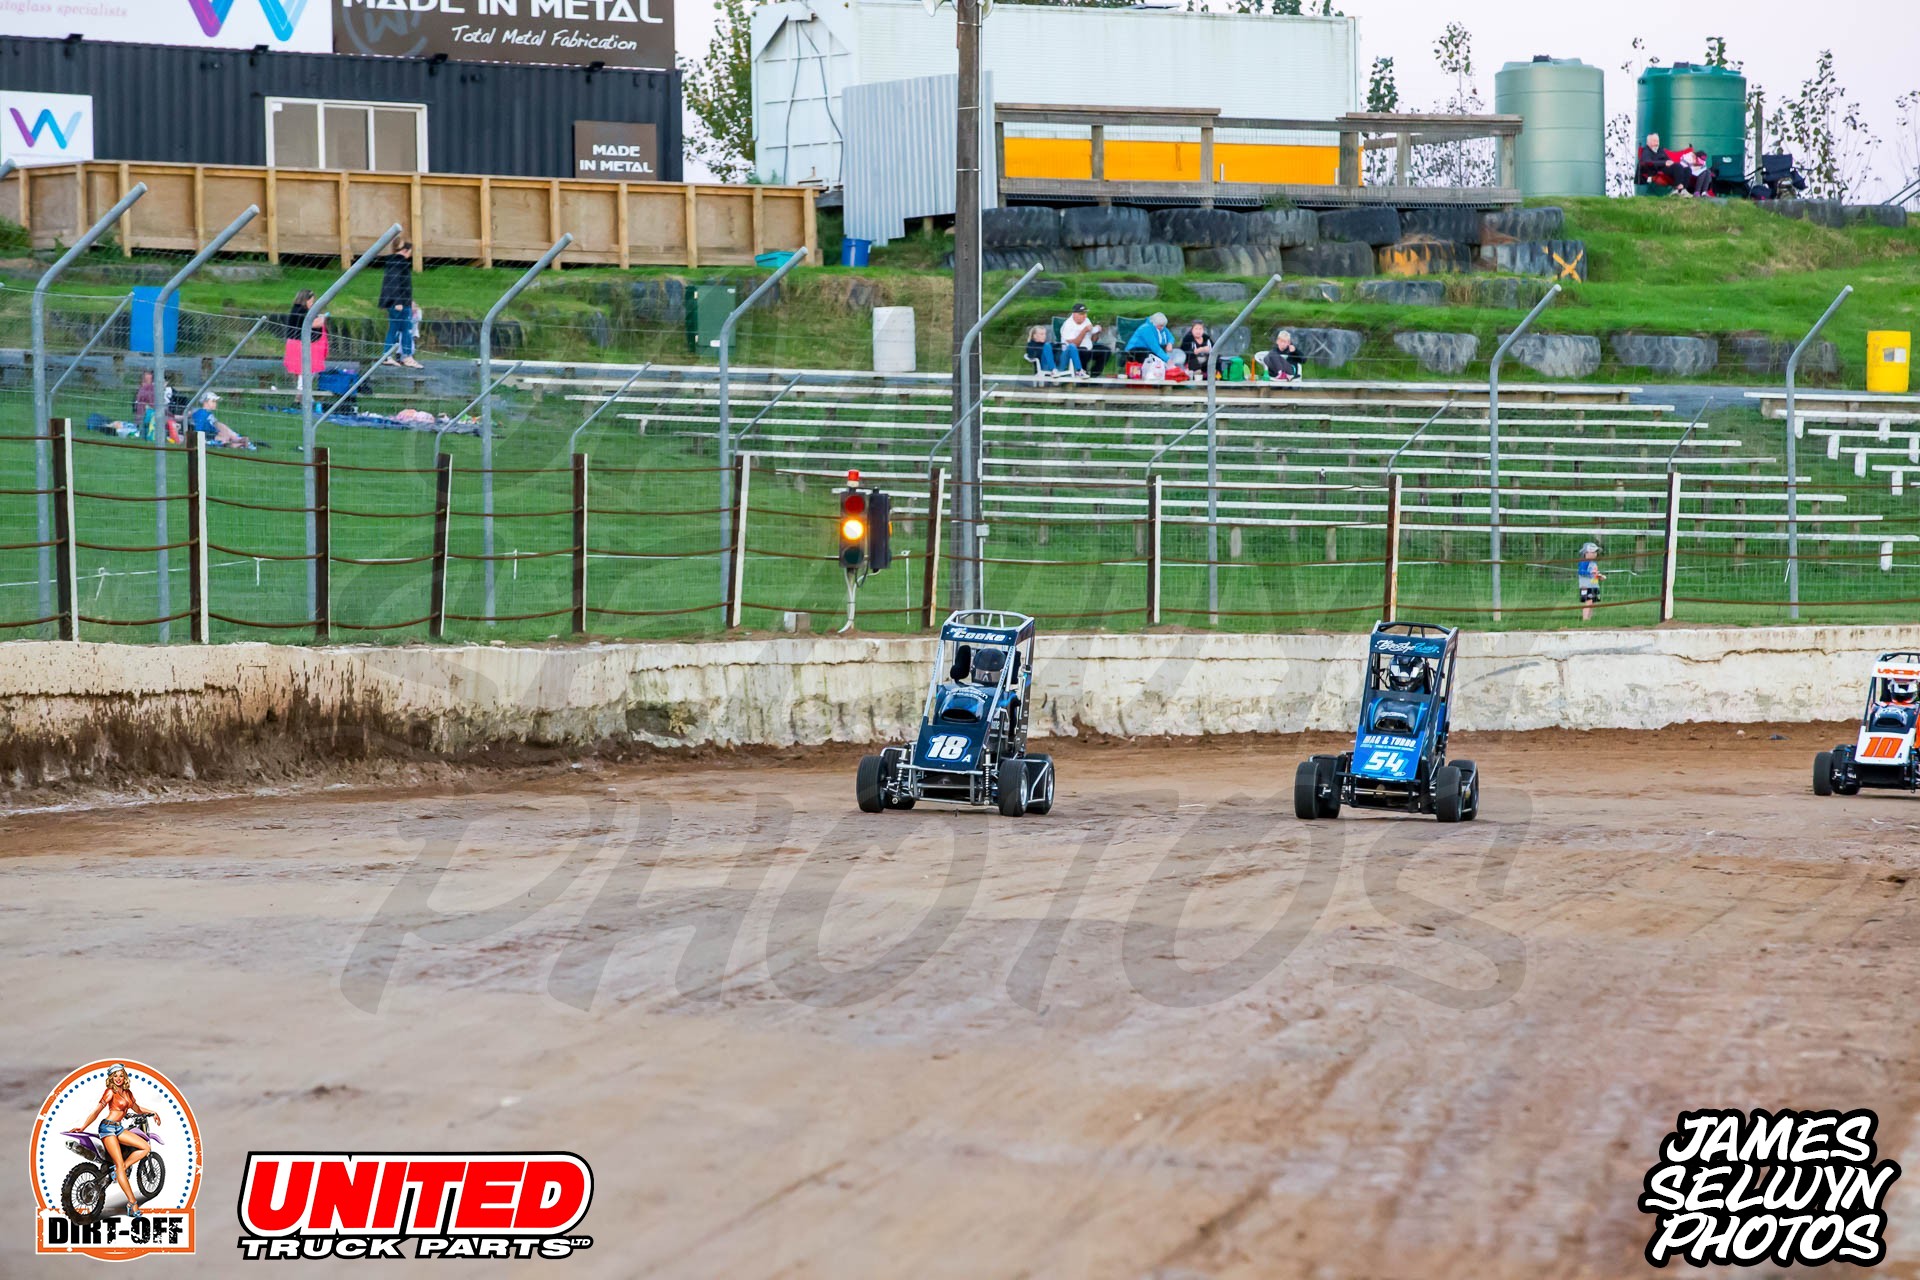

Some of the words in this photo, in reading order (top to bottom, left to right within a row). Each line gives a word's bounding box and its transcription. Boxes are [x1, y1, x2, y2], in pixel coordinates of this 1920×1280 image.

[57, 2, 128, 16] specialists
[531, 0, 664, 24] METAL
[450, 24, 497, 44] Total
[502, 28, 546, 47] Metal
[550, 29, 639, 51] Fabrication
[592, 144, 641, 157] MADE
[579, 159, 597, 170] IN
[600, 160, 654, 173] METAL
[953, 630, 1006, 642] Cooke
[927, 735, 968, 760] 18
[961, 754, 972, 763] A
[1861, 736, 1904, 759] 10
[1363, 750, 1405, 773] 54
